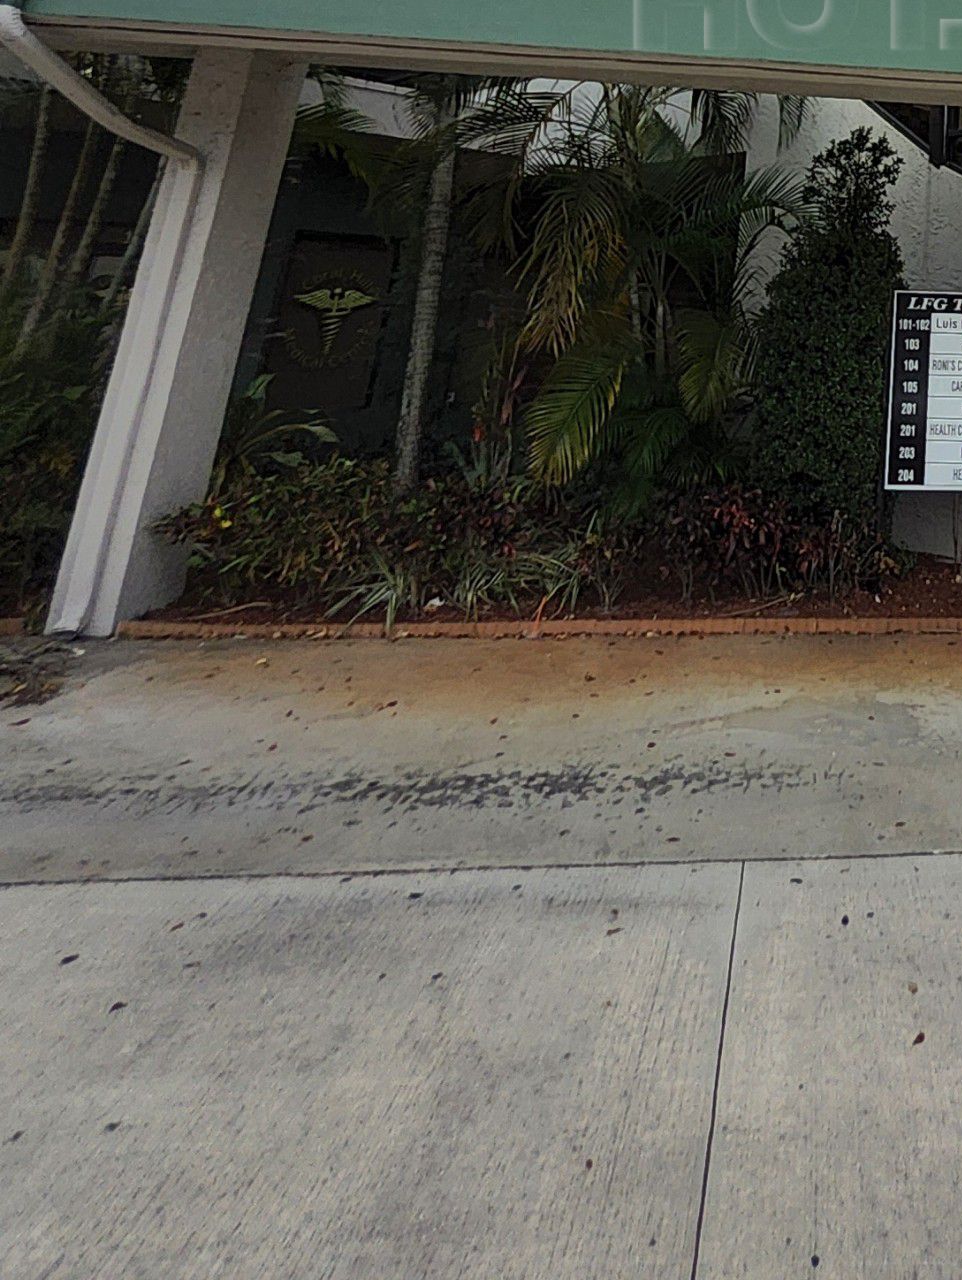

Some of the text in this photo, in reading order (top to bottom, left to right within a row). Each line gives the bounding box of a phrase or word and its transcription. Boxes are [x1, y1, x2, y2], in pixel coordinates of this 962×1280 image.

[907, 297, 948, 310] LFG
[899, 319, 930, 330] 101-102
[936, 319, 958, 329] Luis
[904, 339, 920, 350] 103
[904, 360, 919, 371] 104
[903, 381, 918, 393] 105
[901, 403, 917, 415] 201
[900, 425, 916, 437] 201
[929, 424, 956, 436] HEALTH
[899, 447, 915, 459] 203
[898, 470, 914, 481] 204
